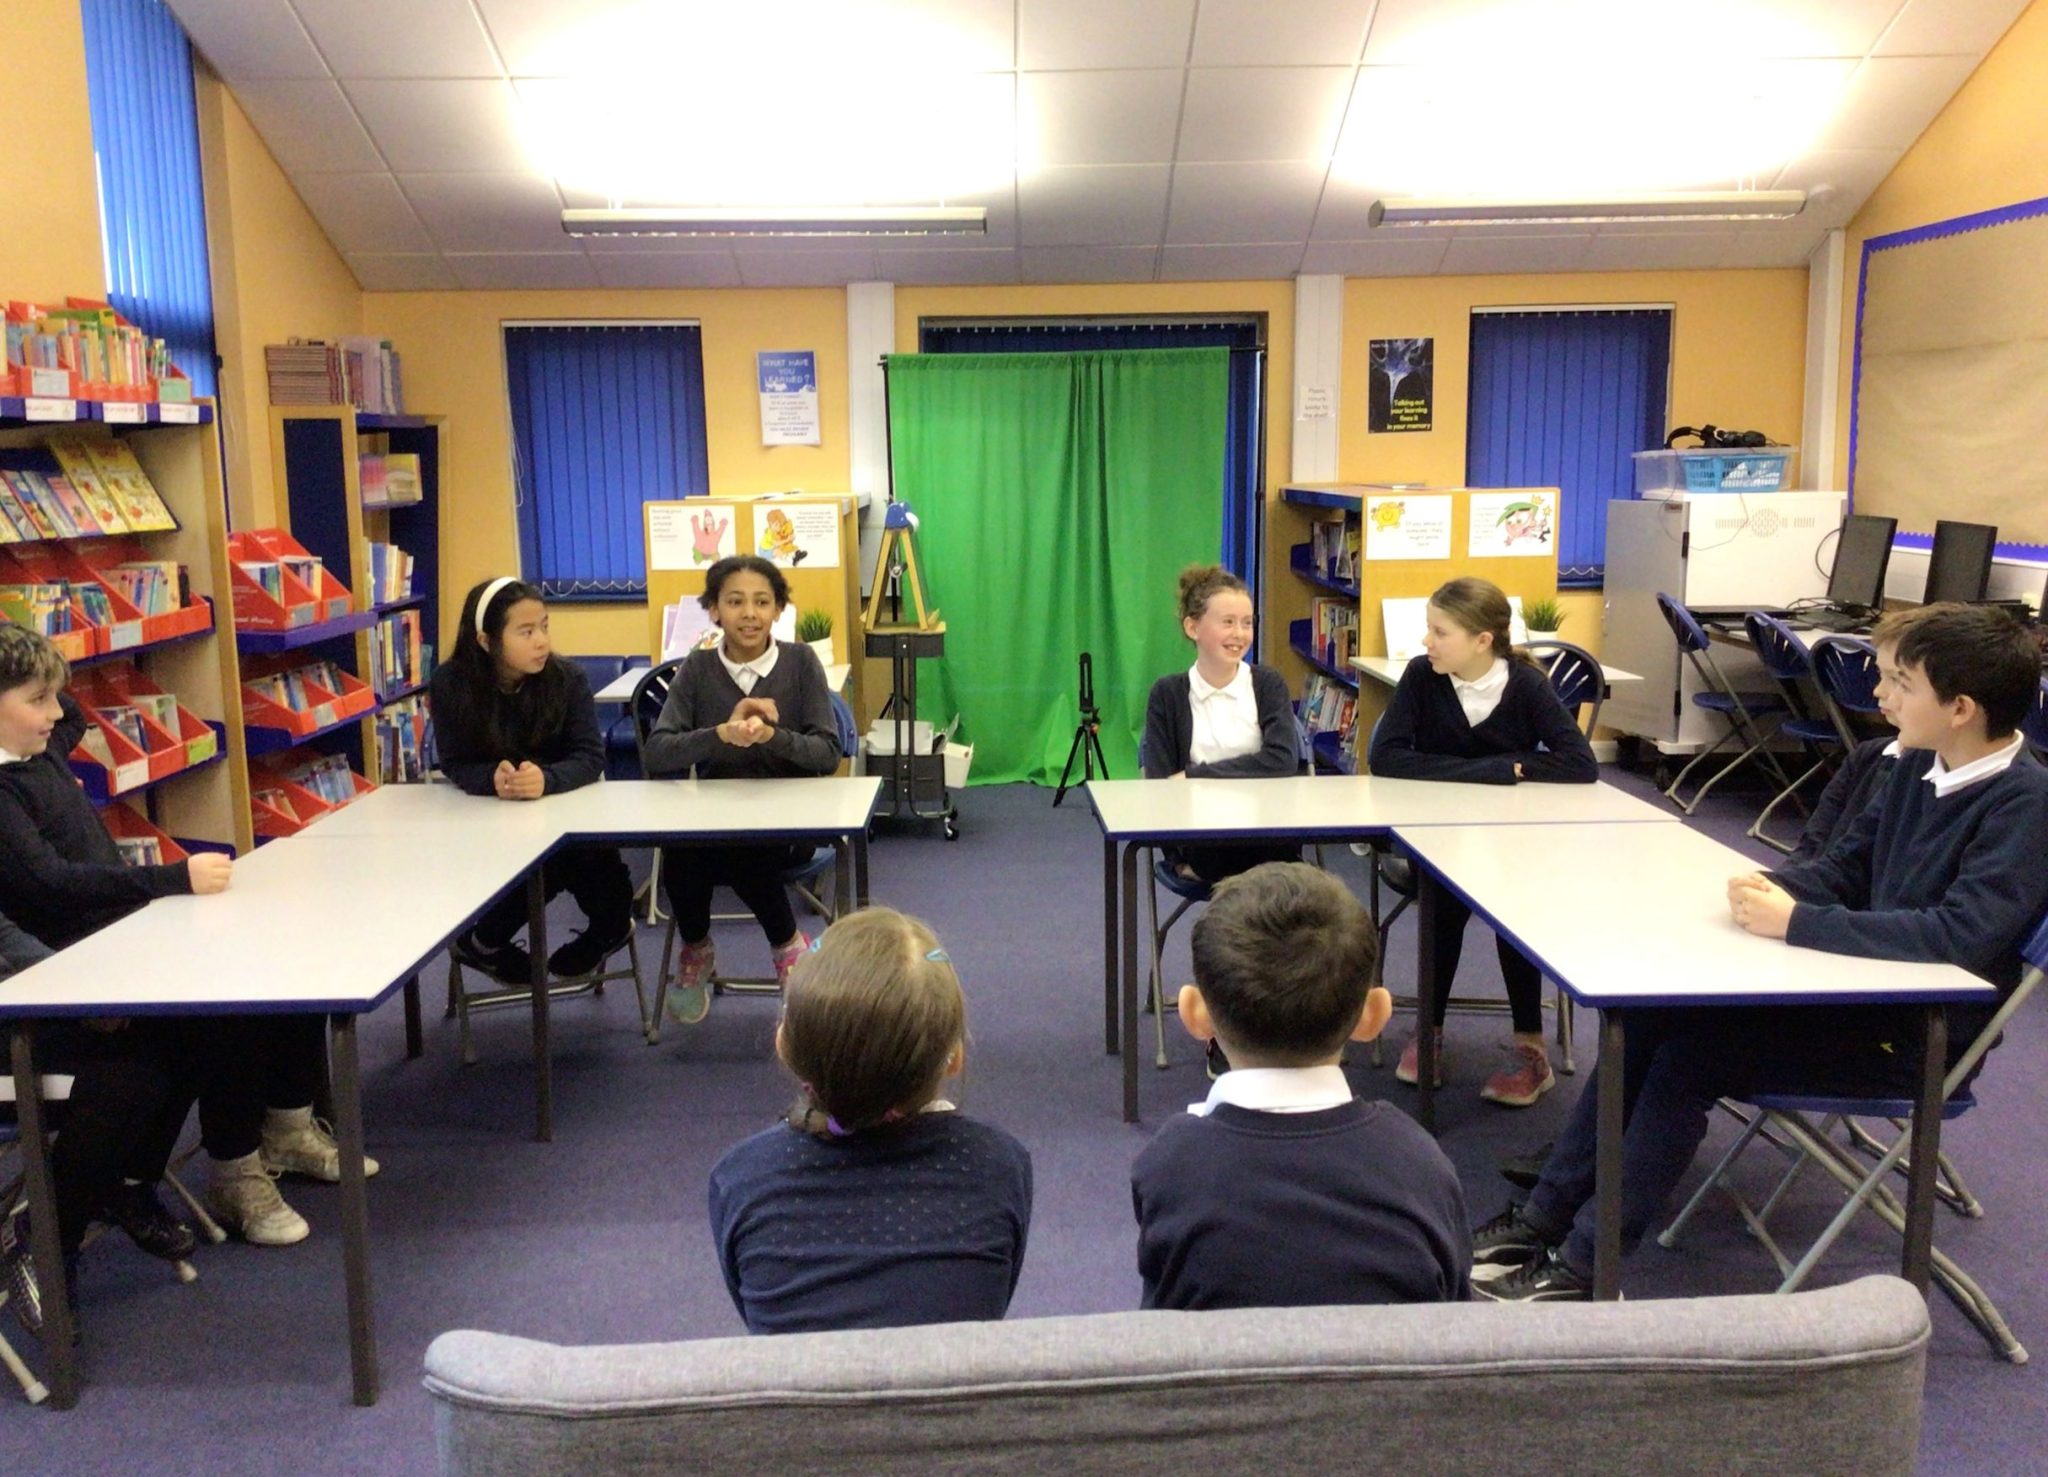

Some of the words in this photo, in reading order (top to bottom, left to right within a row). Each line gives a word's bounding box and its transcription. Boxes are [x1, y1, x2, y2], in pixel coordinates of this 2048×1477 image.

[1394, 399, 1414, 407] Talking
[1391, 408, 1404, 416] your
[1404, 406, 1428, 415] learning
